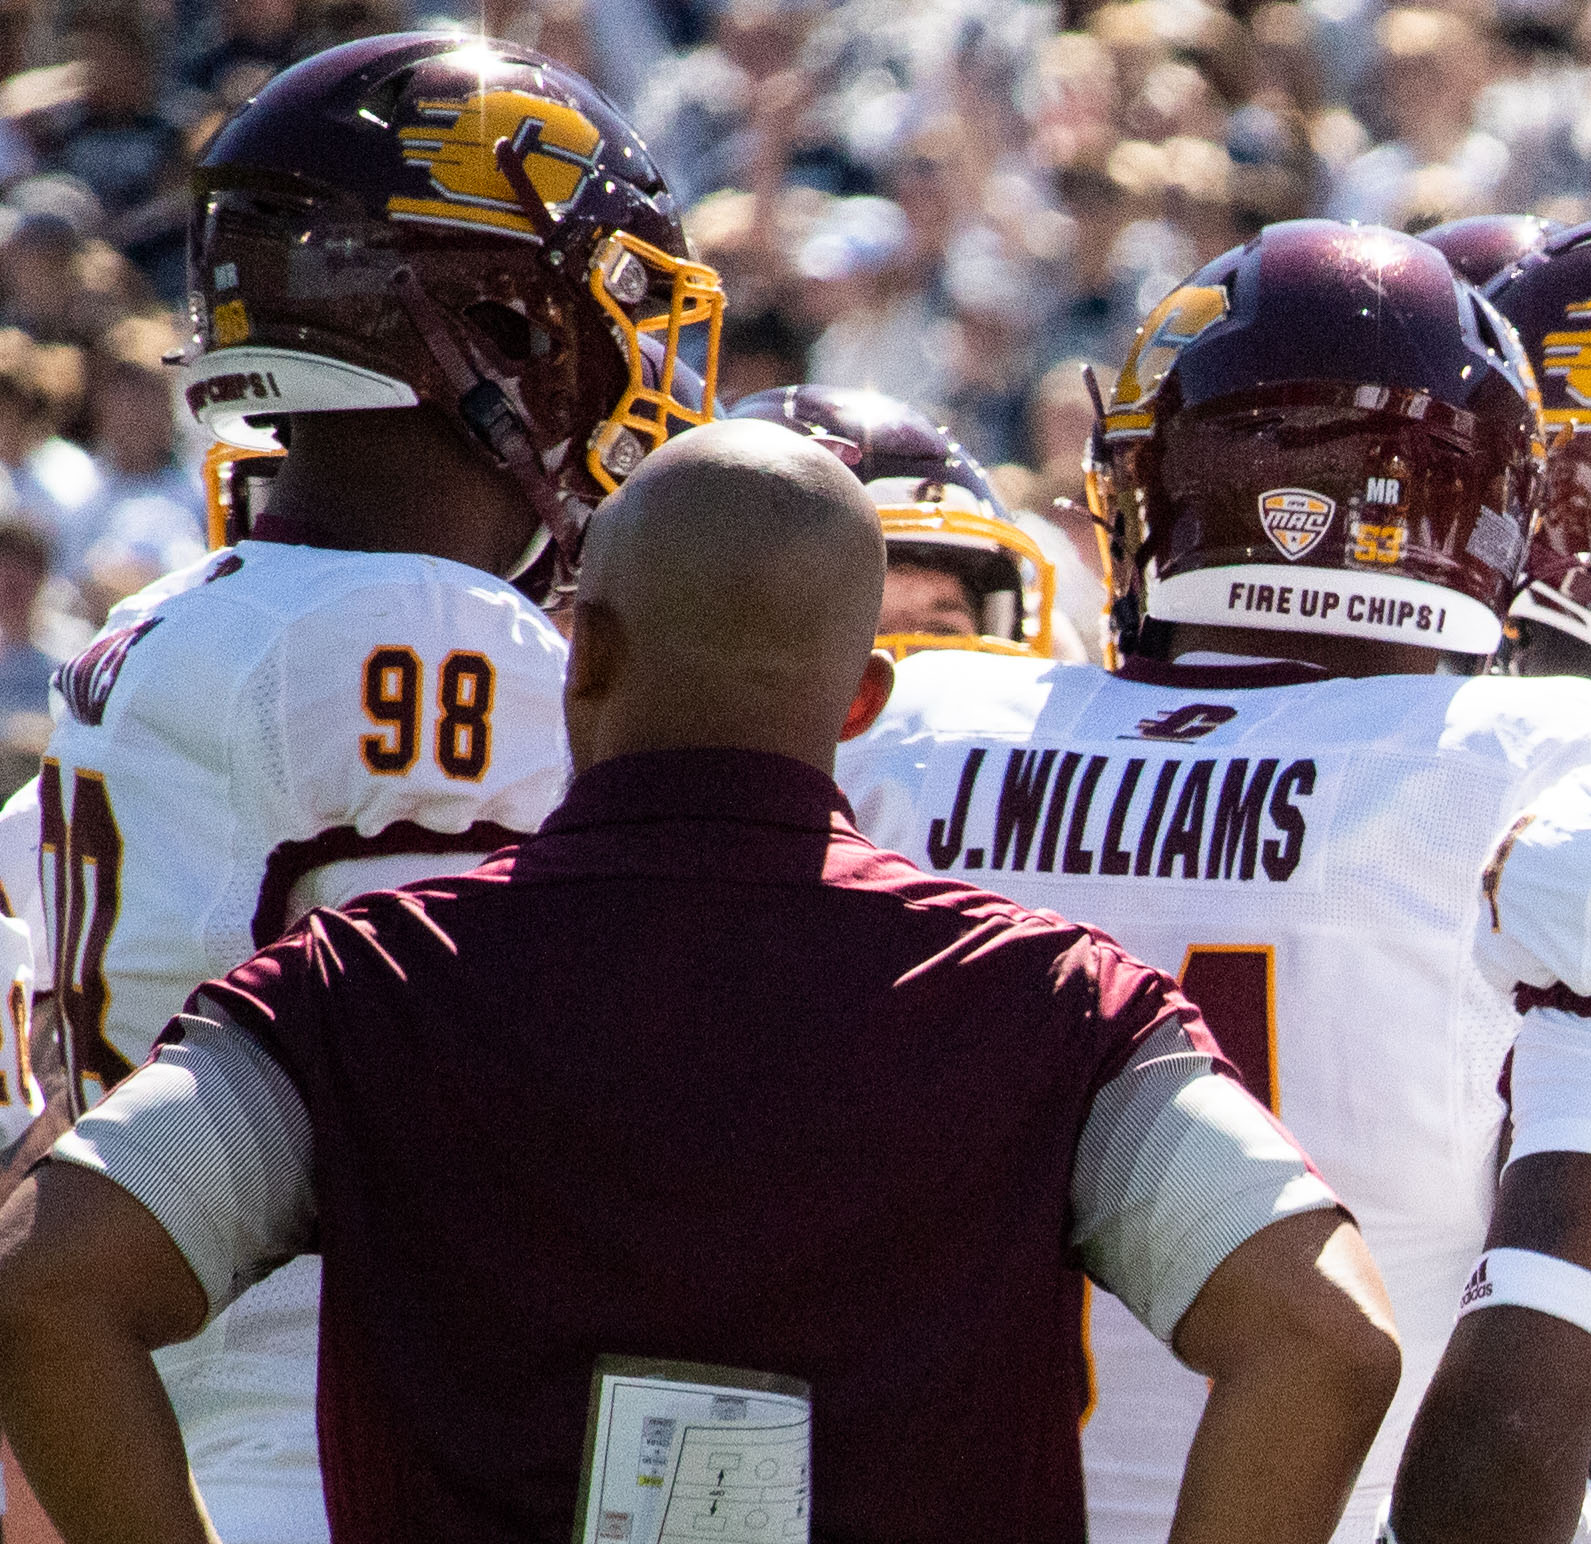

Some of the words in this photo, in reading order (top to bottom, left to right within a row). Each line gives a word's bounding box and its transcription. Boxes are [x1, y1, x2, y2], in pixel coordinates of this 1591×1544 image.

[1366, 477, 1400, 504] MR
[1266, 511, 1325, 530] MAC
[1228, 582, 1293, 614] FIRE
[1300, 590, 1340, 619] UP
[360, 644, 497, 783] 98
[927, 748, 1317, 882] J.WILLIAMS
